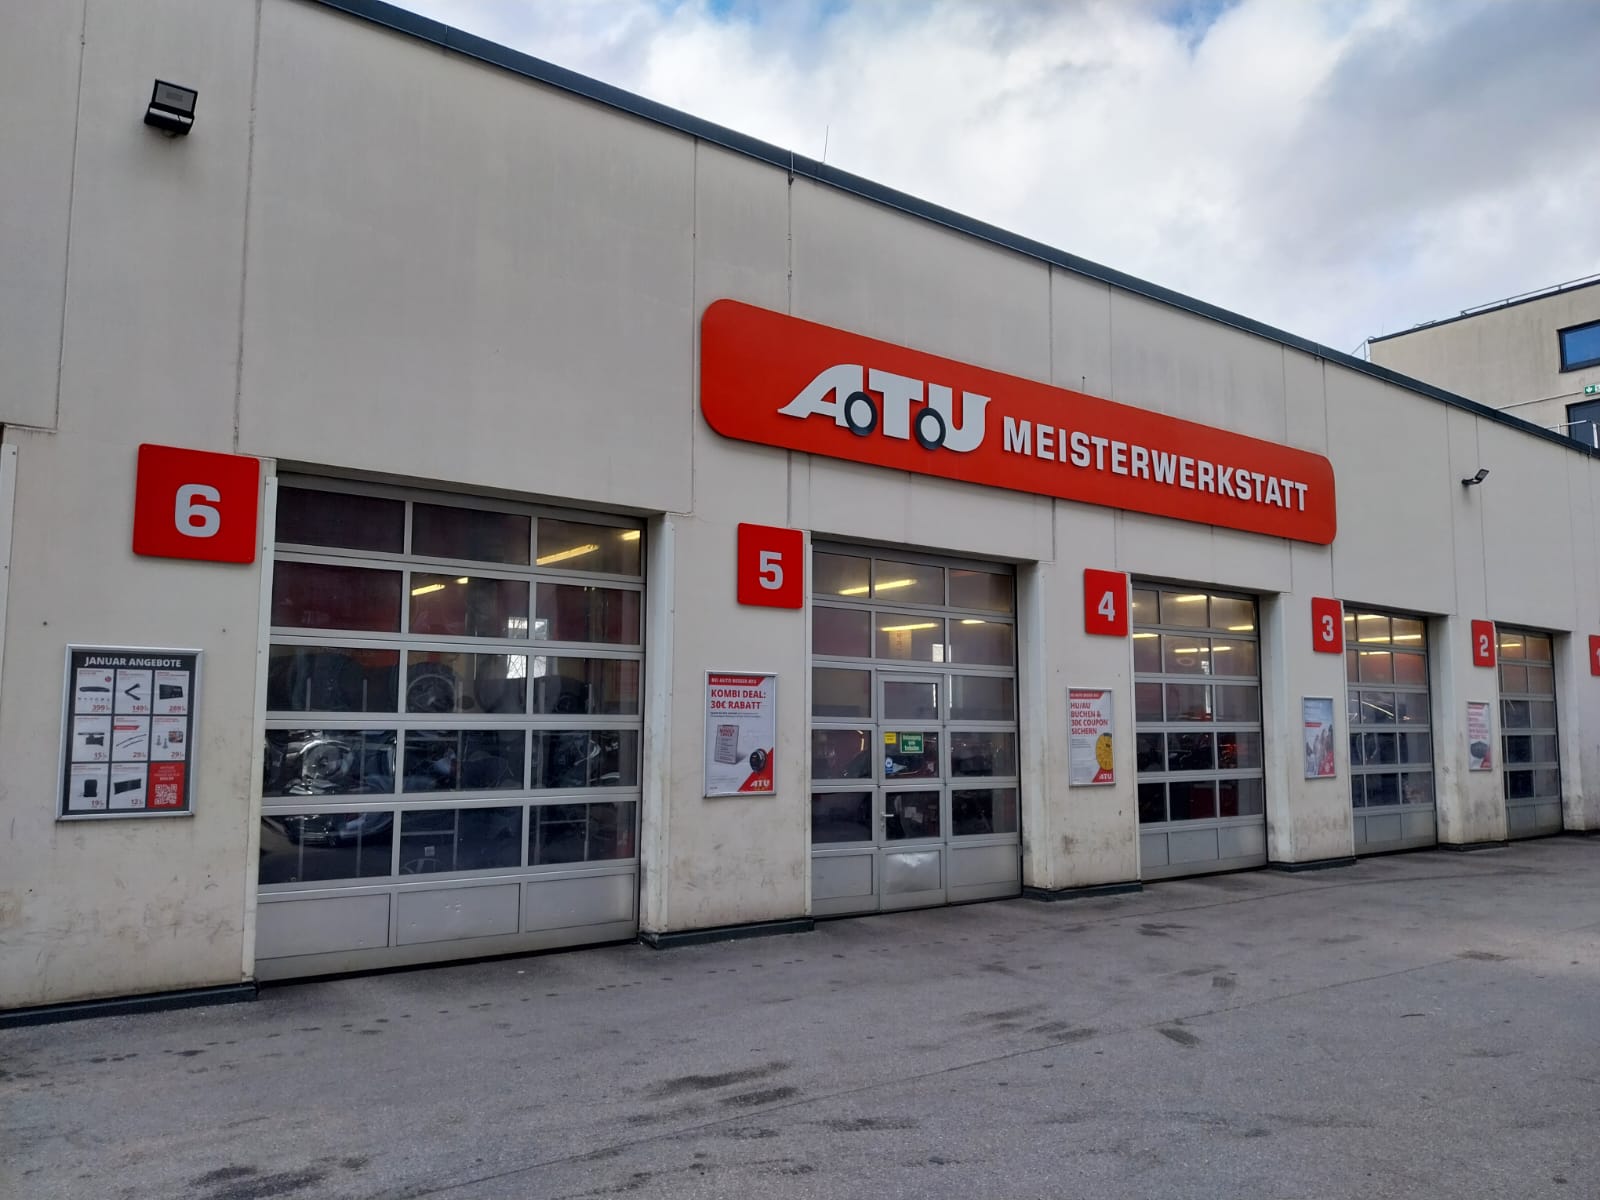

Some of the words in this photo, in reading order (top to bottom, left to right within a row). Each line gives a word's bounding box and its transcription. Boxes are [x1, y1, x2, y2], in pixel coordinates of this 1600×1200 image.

[1003, 416, 1308, 511] MEISTERWERKSTATT
[175, 483, 221, 537] 6
[759, 550, 783, 590] 5
[1098, 591, 1116, 622] 4
[1322, 615, 1334, 641] 3
[1480, 634, 1489, 657] 2
[84, 656, 127, 667] JANUAR
[128, 658, 182, 668] ANGEBOTE
[711, 689, 741, 698] KOMBI
[743, 690, 766, 699] DEAL:
[711, 701, 726, 709] 30€
[728, 702, 761, 710] RABATT
[1083, 719, 1108, 727] COUPON
[750, 779, 770, 787] ATU
